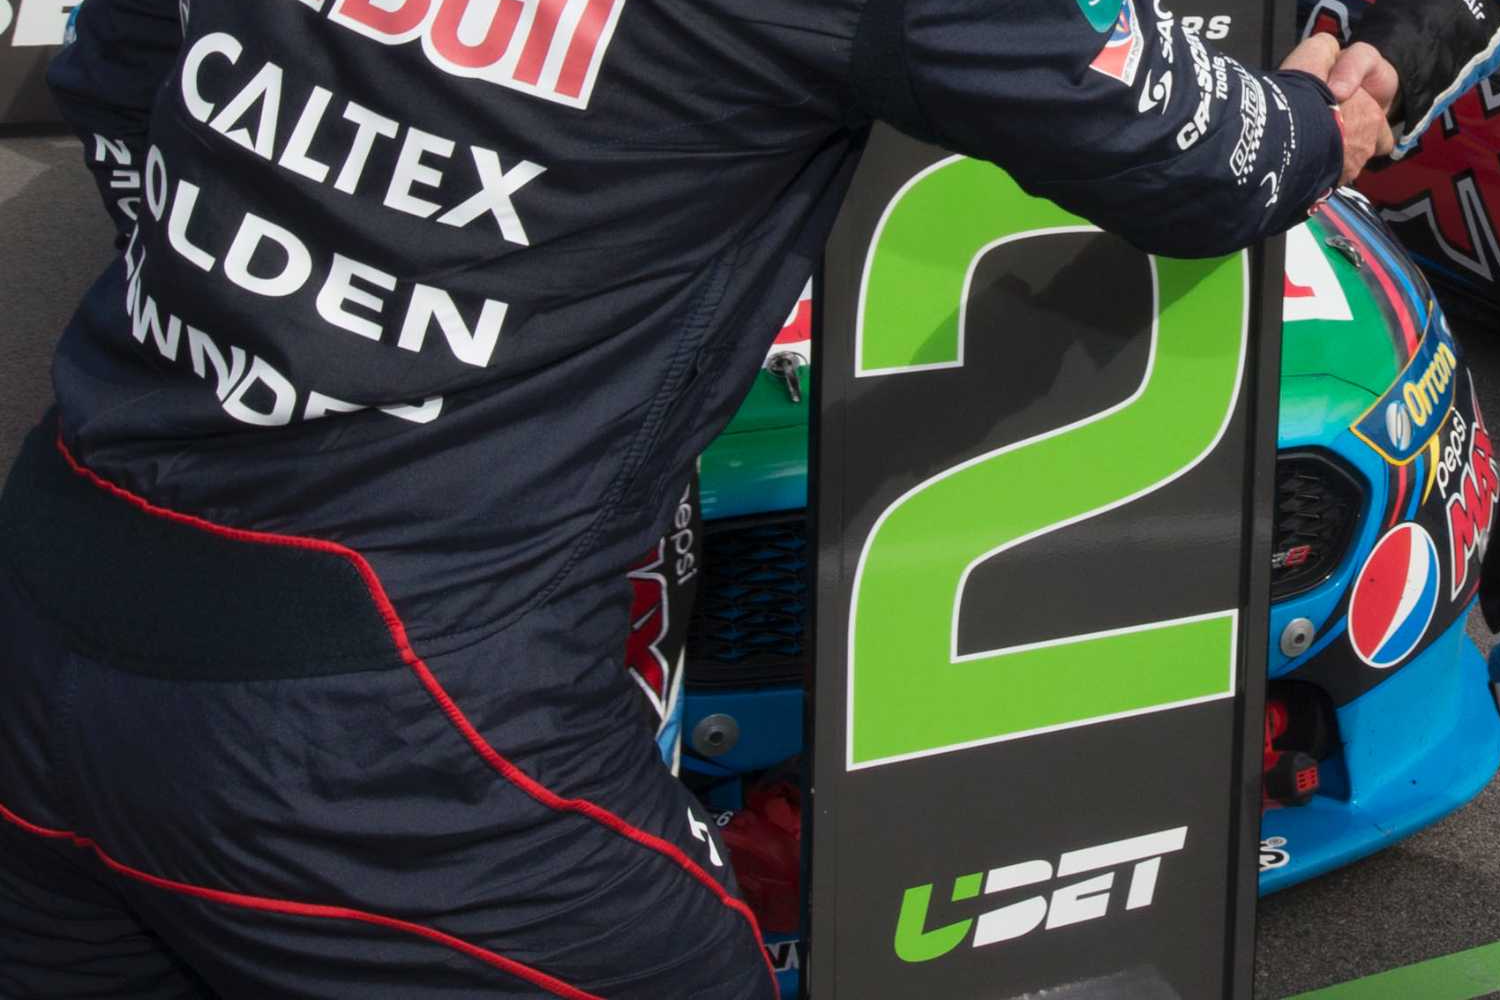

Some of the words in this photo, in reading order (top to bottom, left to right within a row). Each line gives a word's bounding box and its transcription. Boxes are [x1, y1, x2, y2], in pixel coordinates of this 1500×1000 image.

[180, 32, 547, 247] CALTEX
[846, 152, 1250, 771] 2
[1436, 406, 1467, 499] pepsi
[894, 825, 1188, 963] UBET
